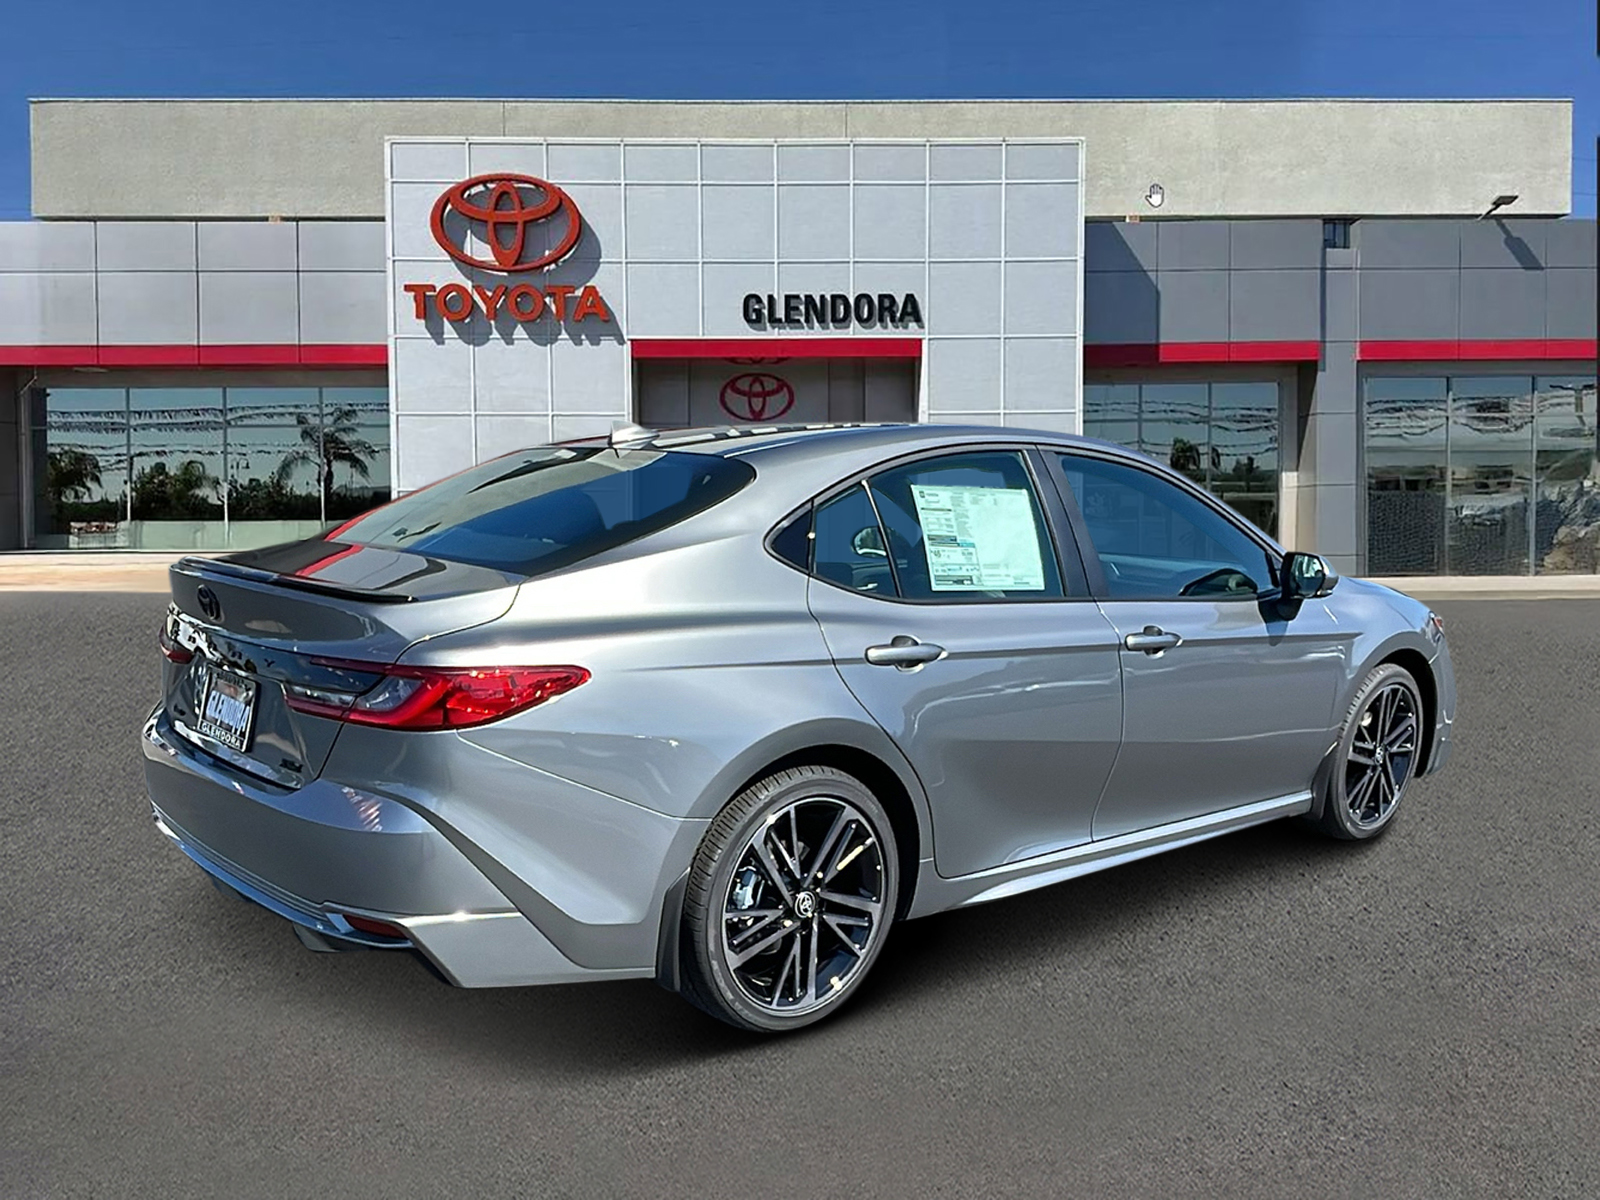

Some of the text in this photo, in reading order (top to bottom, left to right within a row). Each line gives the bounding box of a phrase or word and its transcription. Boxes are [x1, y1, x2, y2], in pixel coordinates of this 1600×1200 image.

[404, 283, 609, 323] TOYOTA
[743, 293, 924, 326] GLENDORA
[201, 722, 241, 747] GLENDORA
